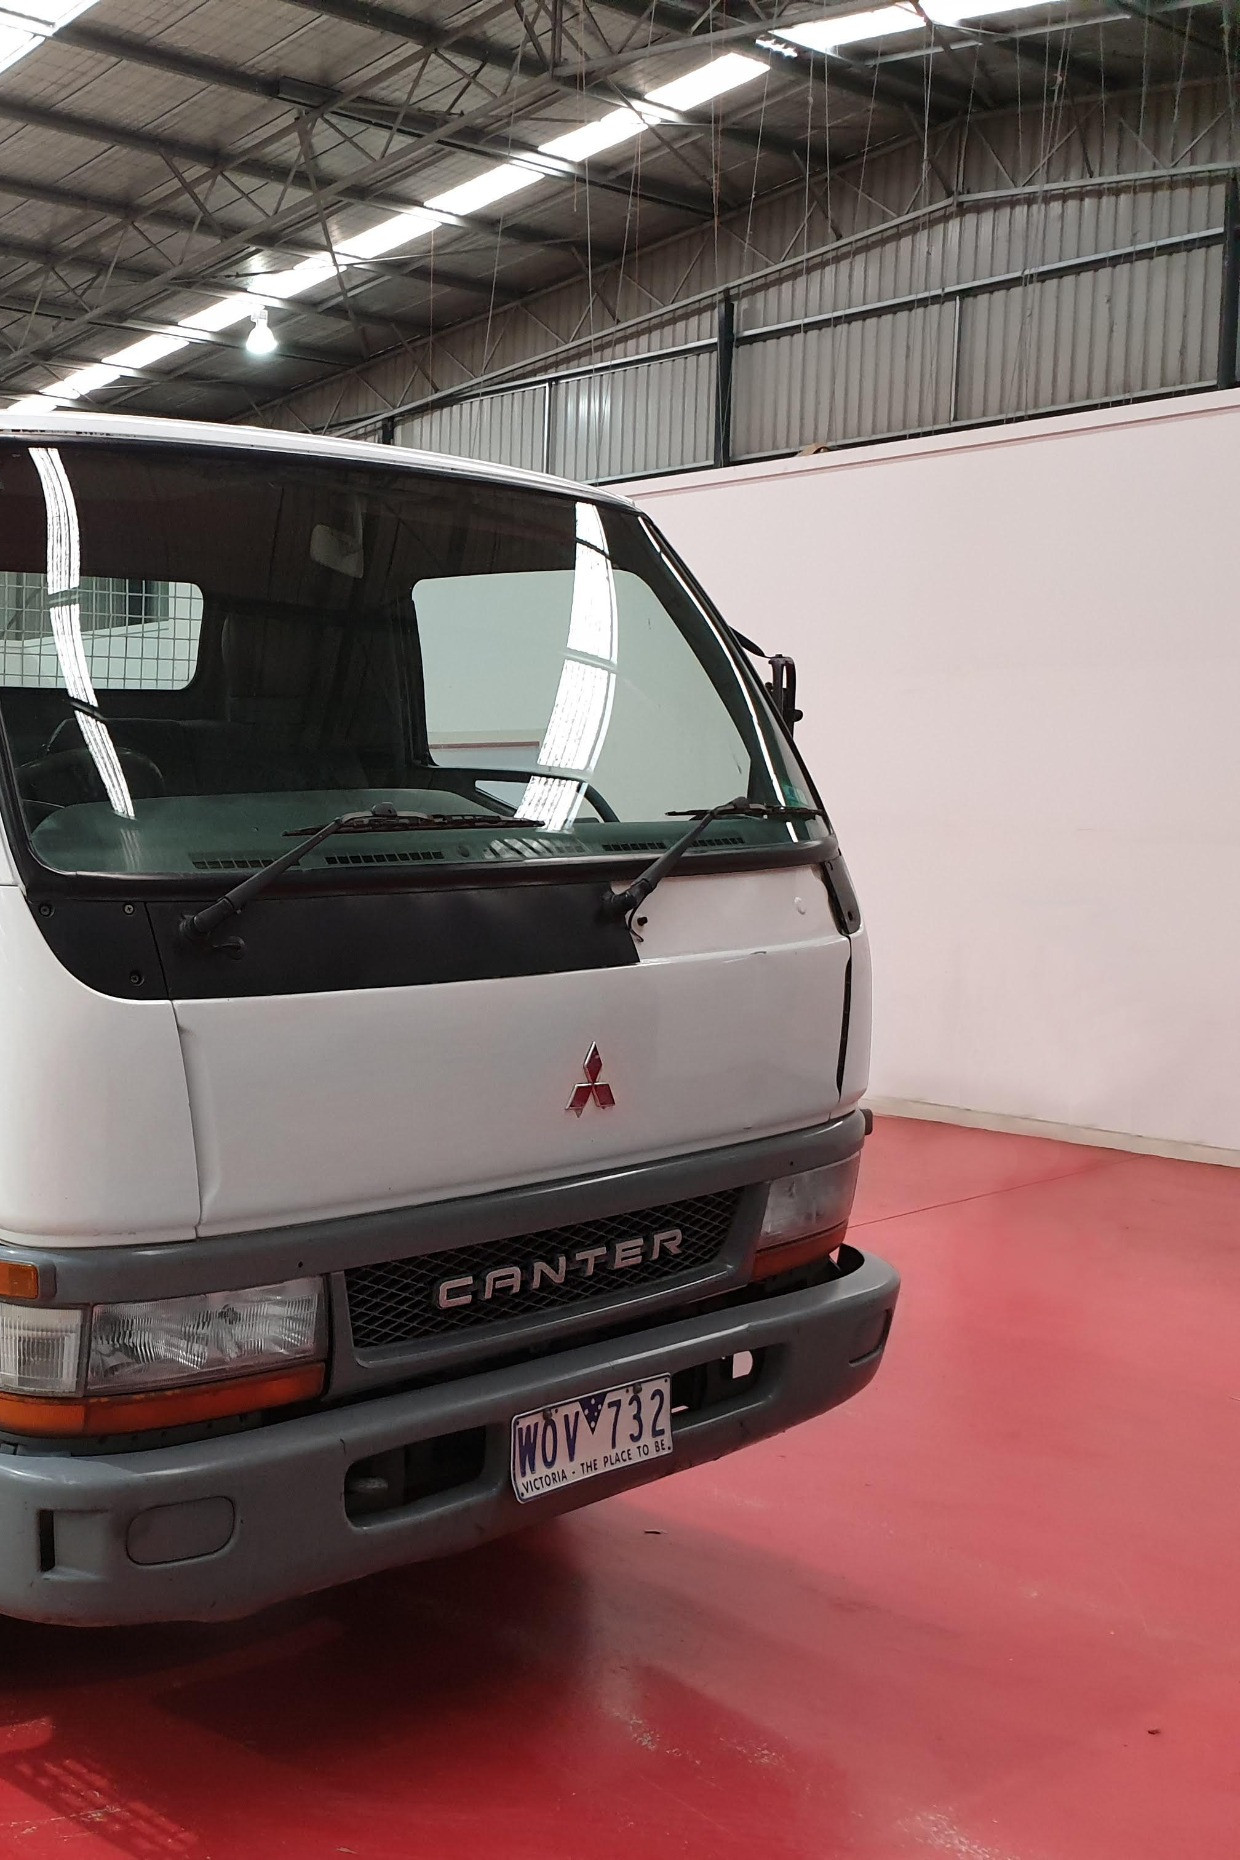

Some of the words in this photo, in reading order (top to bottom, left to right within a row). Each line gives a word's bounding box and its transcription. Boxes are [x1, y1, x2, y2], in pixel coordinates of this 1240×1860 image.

[438, 1229, 682, 1308] CANTER
[518, 1410, 579, 1478] WOV
[608, 1388, 665, 1450] 732
[522, 1468, 567, 1493] VICTORIA
[580, 1458, 598, 1474] THE
[603, 1449, 632, 1468] PLACE
[637, 1444, 650, 1457] TO
[655, 1439, 665, 1452] BE
